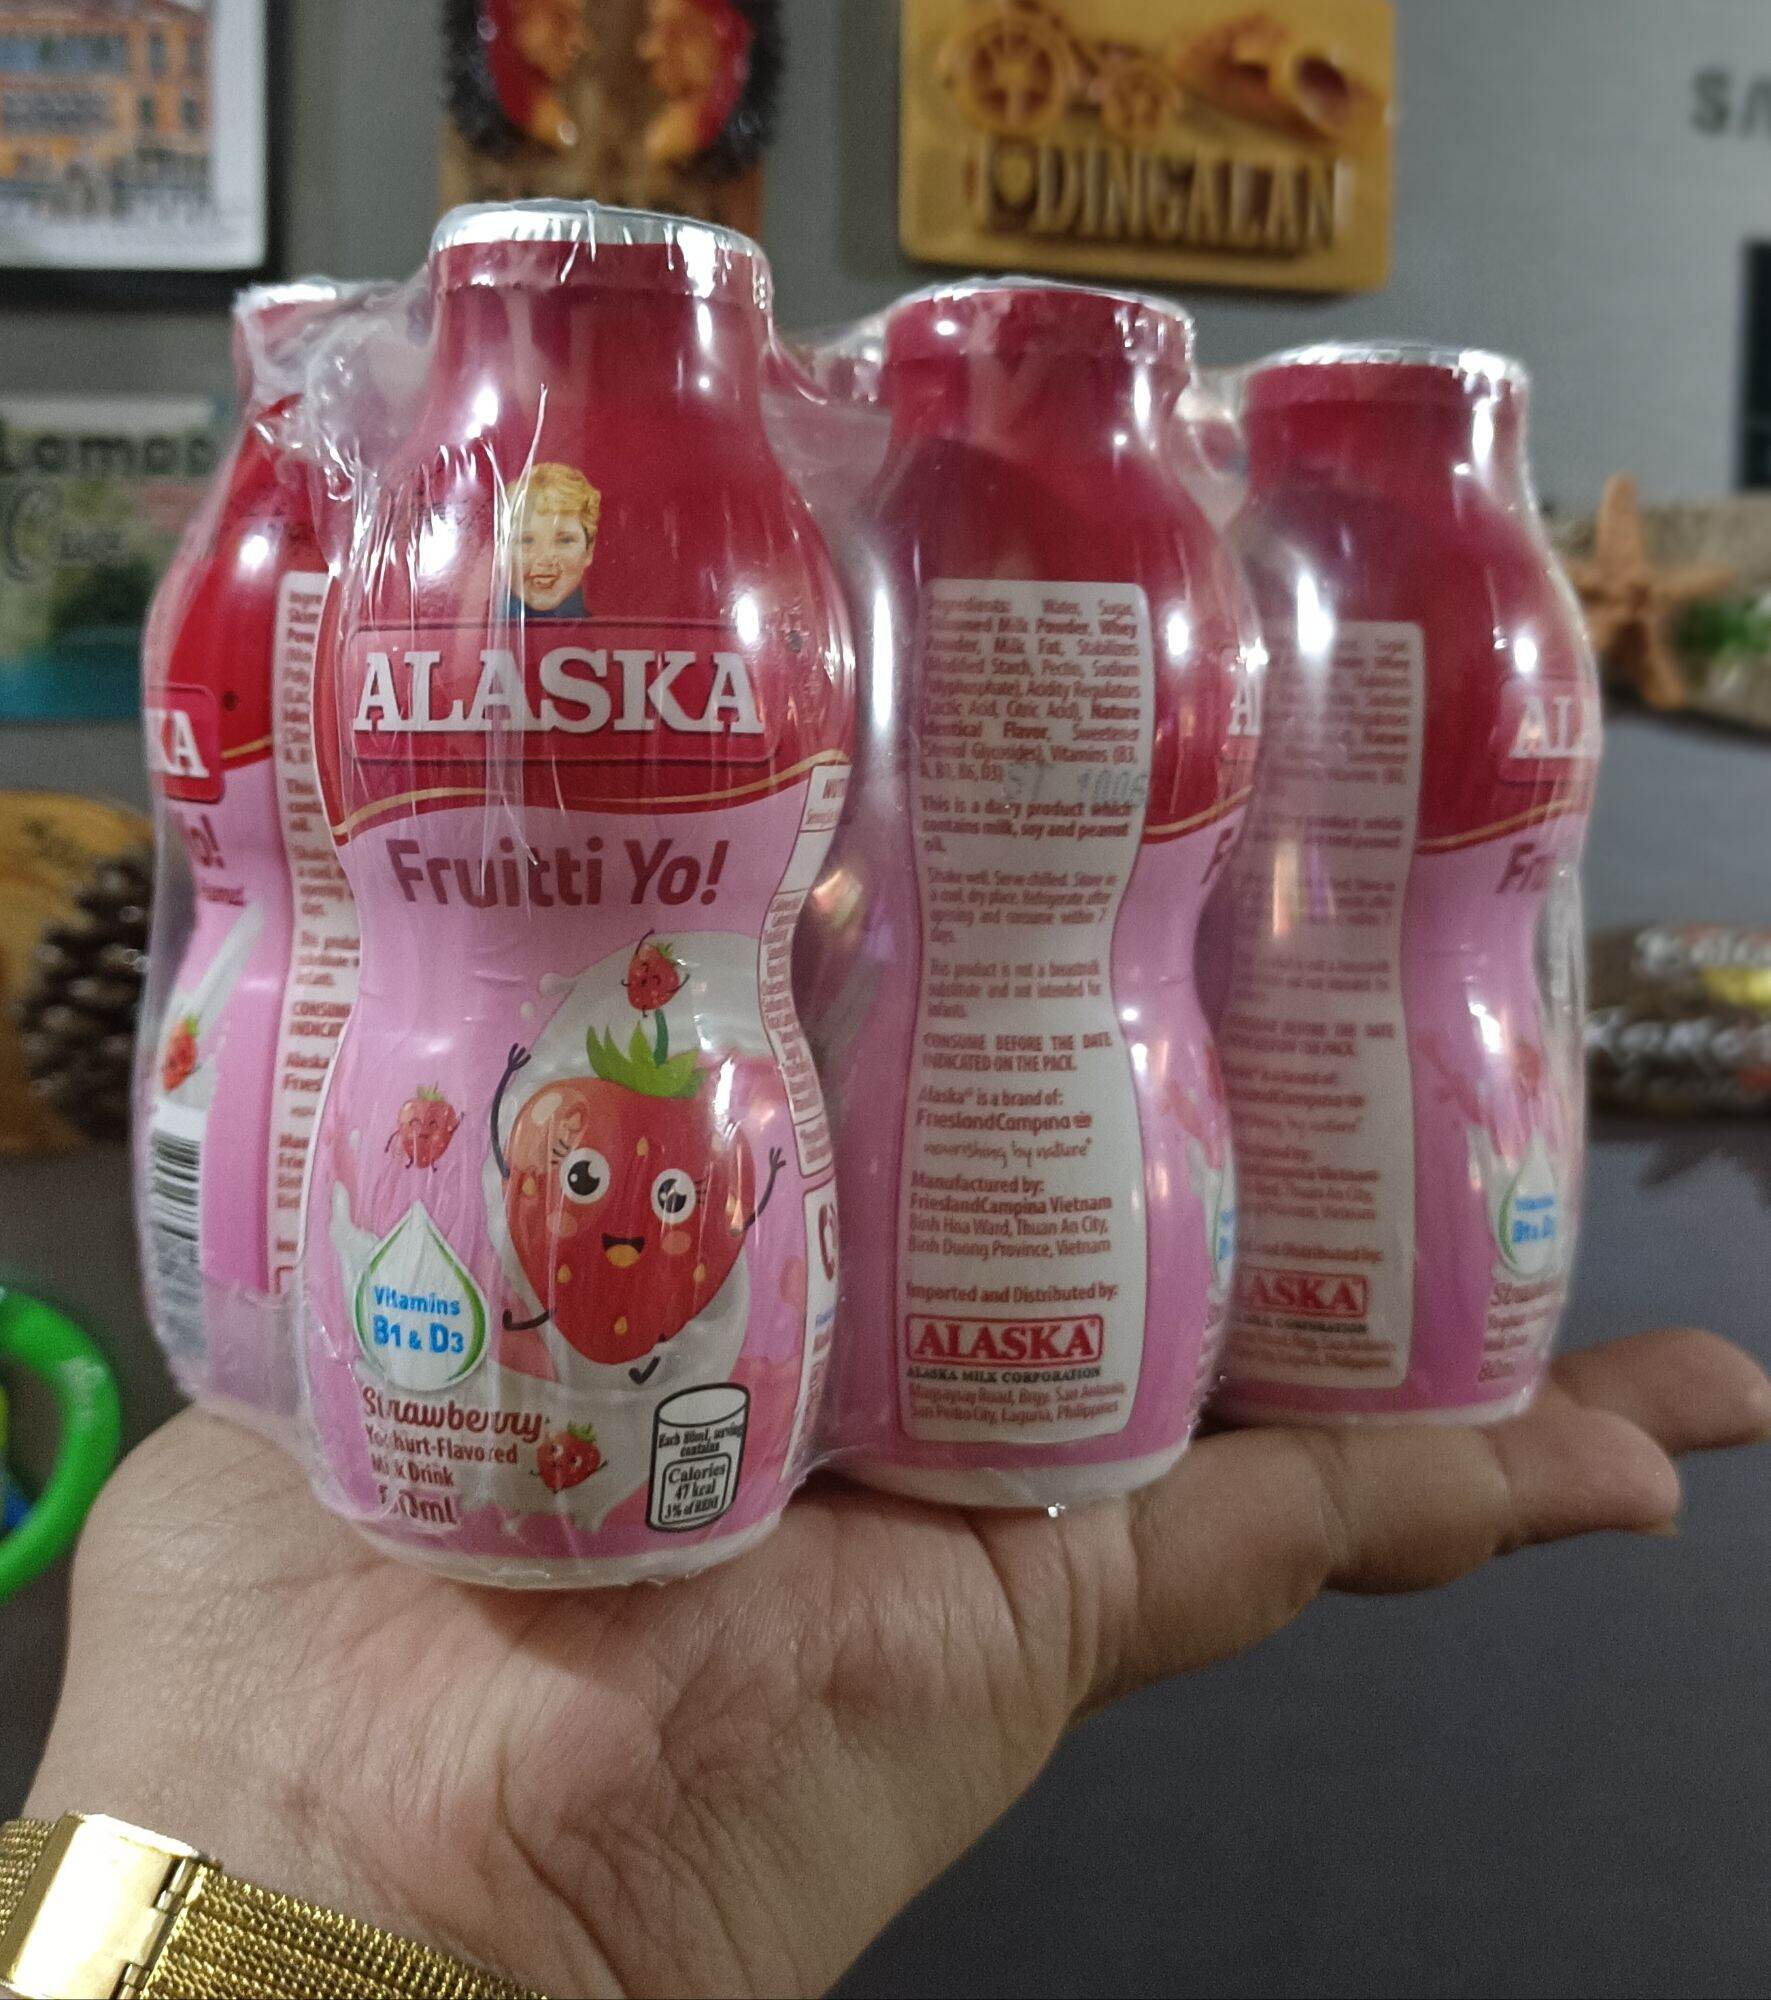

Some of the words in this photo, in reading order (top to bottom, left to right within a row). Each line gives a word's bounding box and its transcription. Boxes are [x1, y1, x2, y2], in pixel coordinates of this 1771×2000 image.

[1036, 140, 1357, 252] DINGALAN
[352, 647, 766, 735] ALASKA
[1026, 801, 1085, 820] product
[1078, 822, 1130, 842] peanut
[386, 837, 603, 909] Fruitti
[624, 839, 730, 908] Yo!
[923, 1031, 986, 1051] CONSUME
[995, 1033, 1043, 1051] BEFORE
[1052, 1034, 1074, 1051] THE
[1016, 1054, 1040, 1072] THE
[976, 1088, 988, 1106] is
[1002, 1087, 1042, 1107] brand
[915, 1108, 1071, 1136] FrieslandCampina
[911, 1170, 1019, 1194] Manufactured
[1022, 1176, 1045, 1197] by:
[1050, 1195, 1114, 1214] Vietnam
[1061, 1218, 1079, 1235] An
[1082, 1215, 1109, 1235] City,
[1055, 1239, 1112, 1257] Vietnam
[373, 1285, 461, 1316] Vitamins
[906, 1280, 978, 1303] Imported
[981, 1285, 1010, 1304] and
[1014, 1281, 1096, 1303] Distributed
[1098, 1280, 1118, 1301] by:
[373, 1314, 402, 1348] B1
[408, 1329, 423, 1351] &
[429, 1322, 465, 1355] D3
[915, 1321, 1096, 1361] ALASKA
[905, 1366, 958, 1382] ALASKA
[962, 1370, 998, 1383] MILK
[1001, 1366, 1101, 1384] CORPORATION
[365, 1423, 519, 1465] Yohurt-Flavored
[408, 1459, 455, 1488] Drink
[668, 1462, 727, 1484] Calories
[674, 1482, 691, 1501] 47
[692, 1479, 717, 1497] kcal
